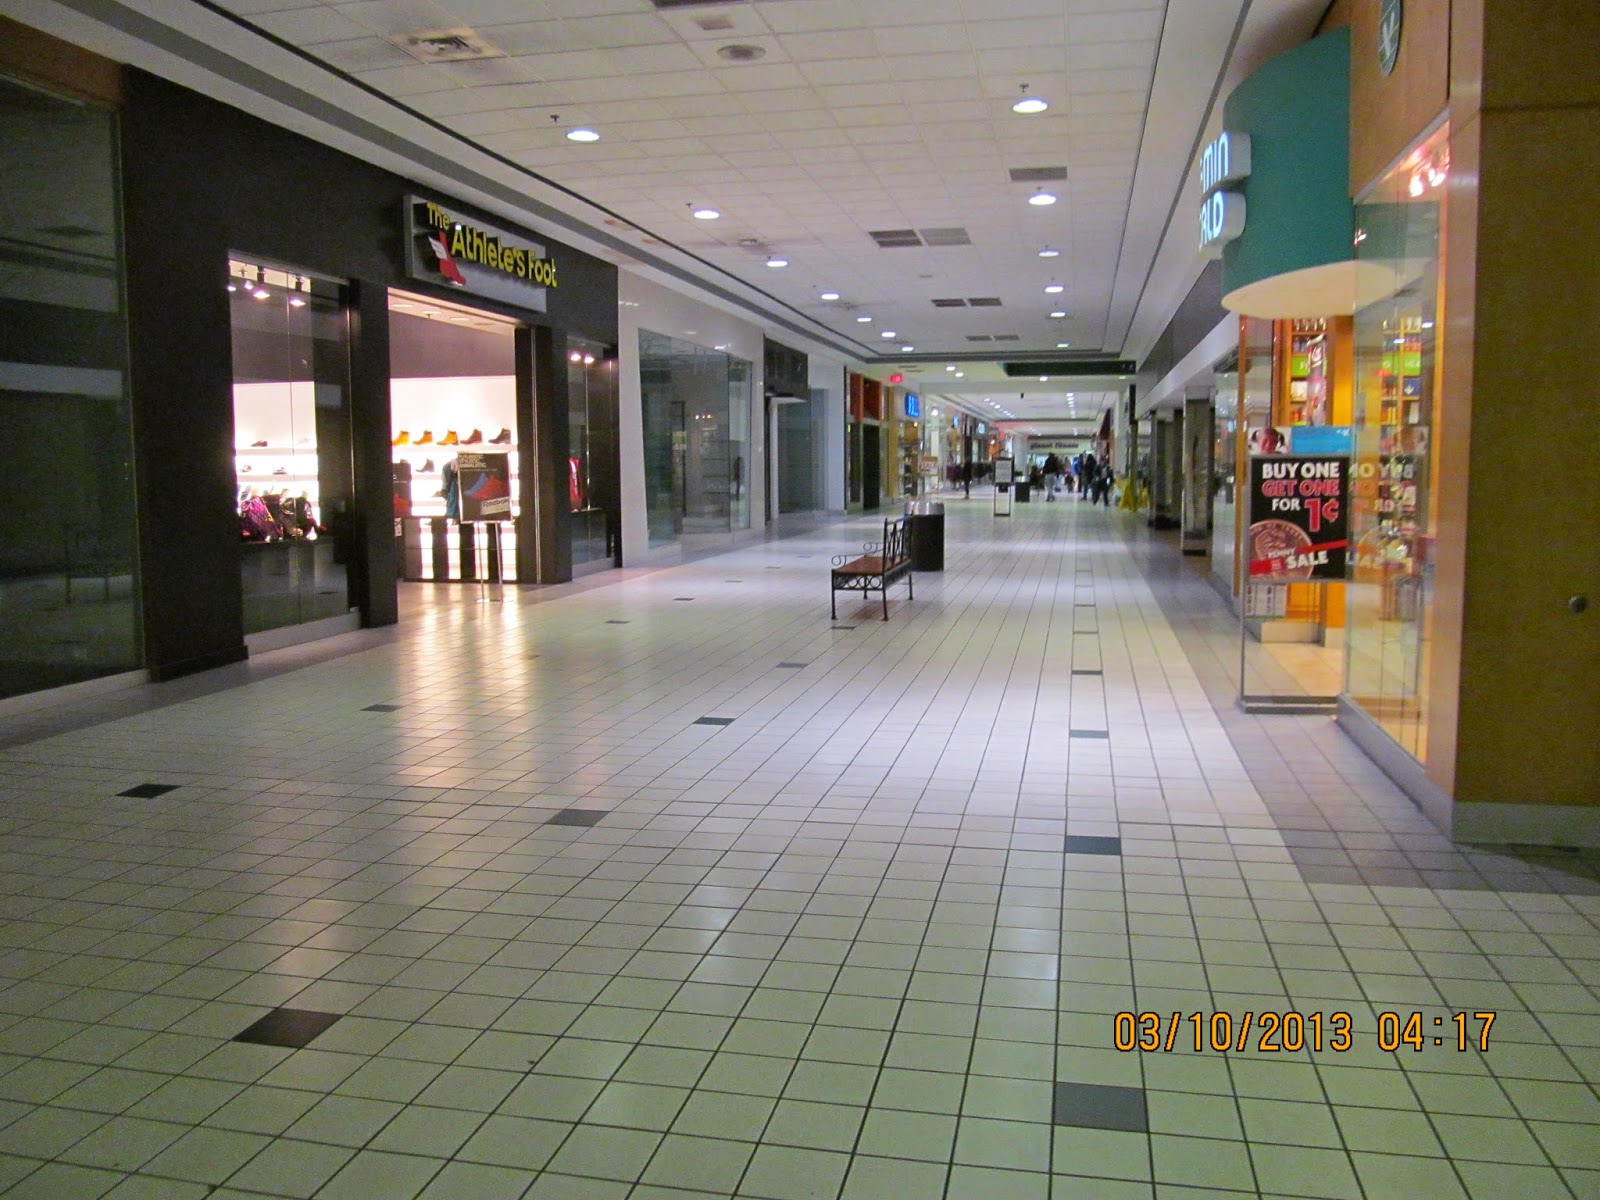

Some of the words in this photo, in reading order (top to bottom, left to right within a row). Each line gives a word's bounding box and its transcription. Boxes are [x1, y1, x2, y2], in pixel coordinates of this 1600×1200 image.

[427, 202, 450, 231] The
[451, 224, 525, 278] Athlete's
[528, 249, 557, 288] Foot
[1262, 462, 1300, 479] BUY
[1301, 461, 1340, 479] ONE
[1262, 479, 1298, 497] GET
[1300, 479, 1340, 497] ONE
[1272, 498, 1300, 511] FOR
[1304, 498, 1339, 532] 1¢
[1286, 550, 1329, 569] SALE
